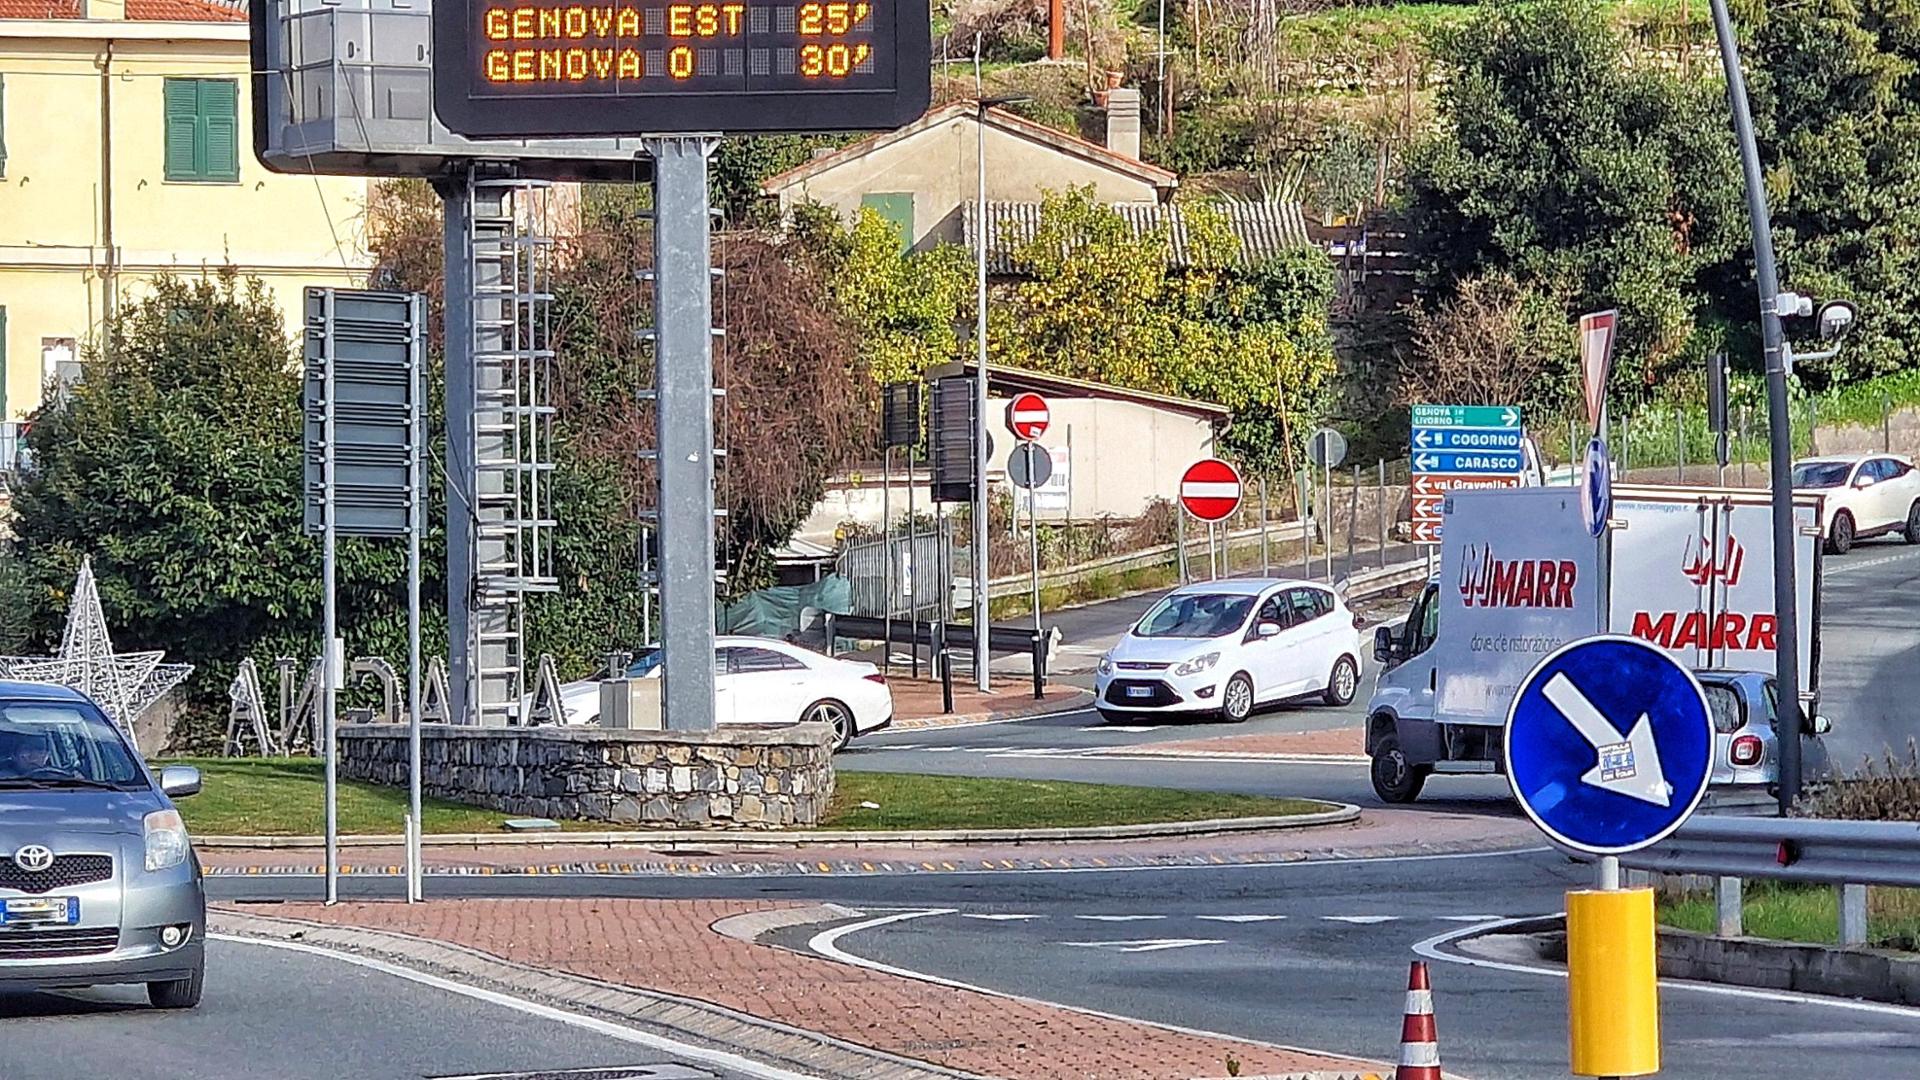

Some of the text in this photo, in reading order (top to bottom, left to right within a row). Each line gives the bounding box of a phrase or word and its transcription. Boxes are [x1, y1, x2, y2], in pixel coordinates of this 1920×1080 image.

[487, 6, 639, 42] GENOVA
[670, 3, 743, 40] EST
[488, 48, 639, 84] GENOVA
[1414, 407, 1451, 416] GENOVA
[1414, 416, 1453, 425] LIVORNO
[1451, 433, 1518, 446] COGORNO
[1455, 456, 1518, 469] CARASCO
[1434, 479, 1451, 490] val
[1490, 559, 1577, 608] MARR
[1630, 611, 1777, 651] MARR
